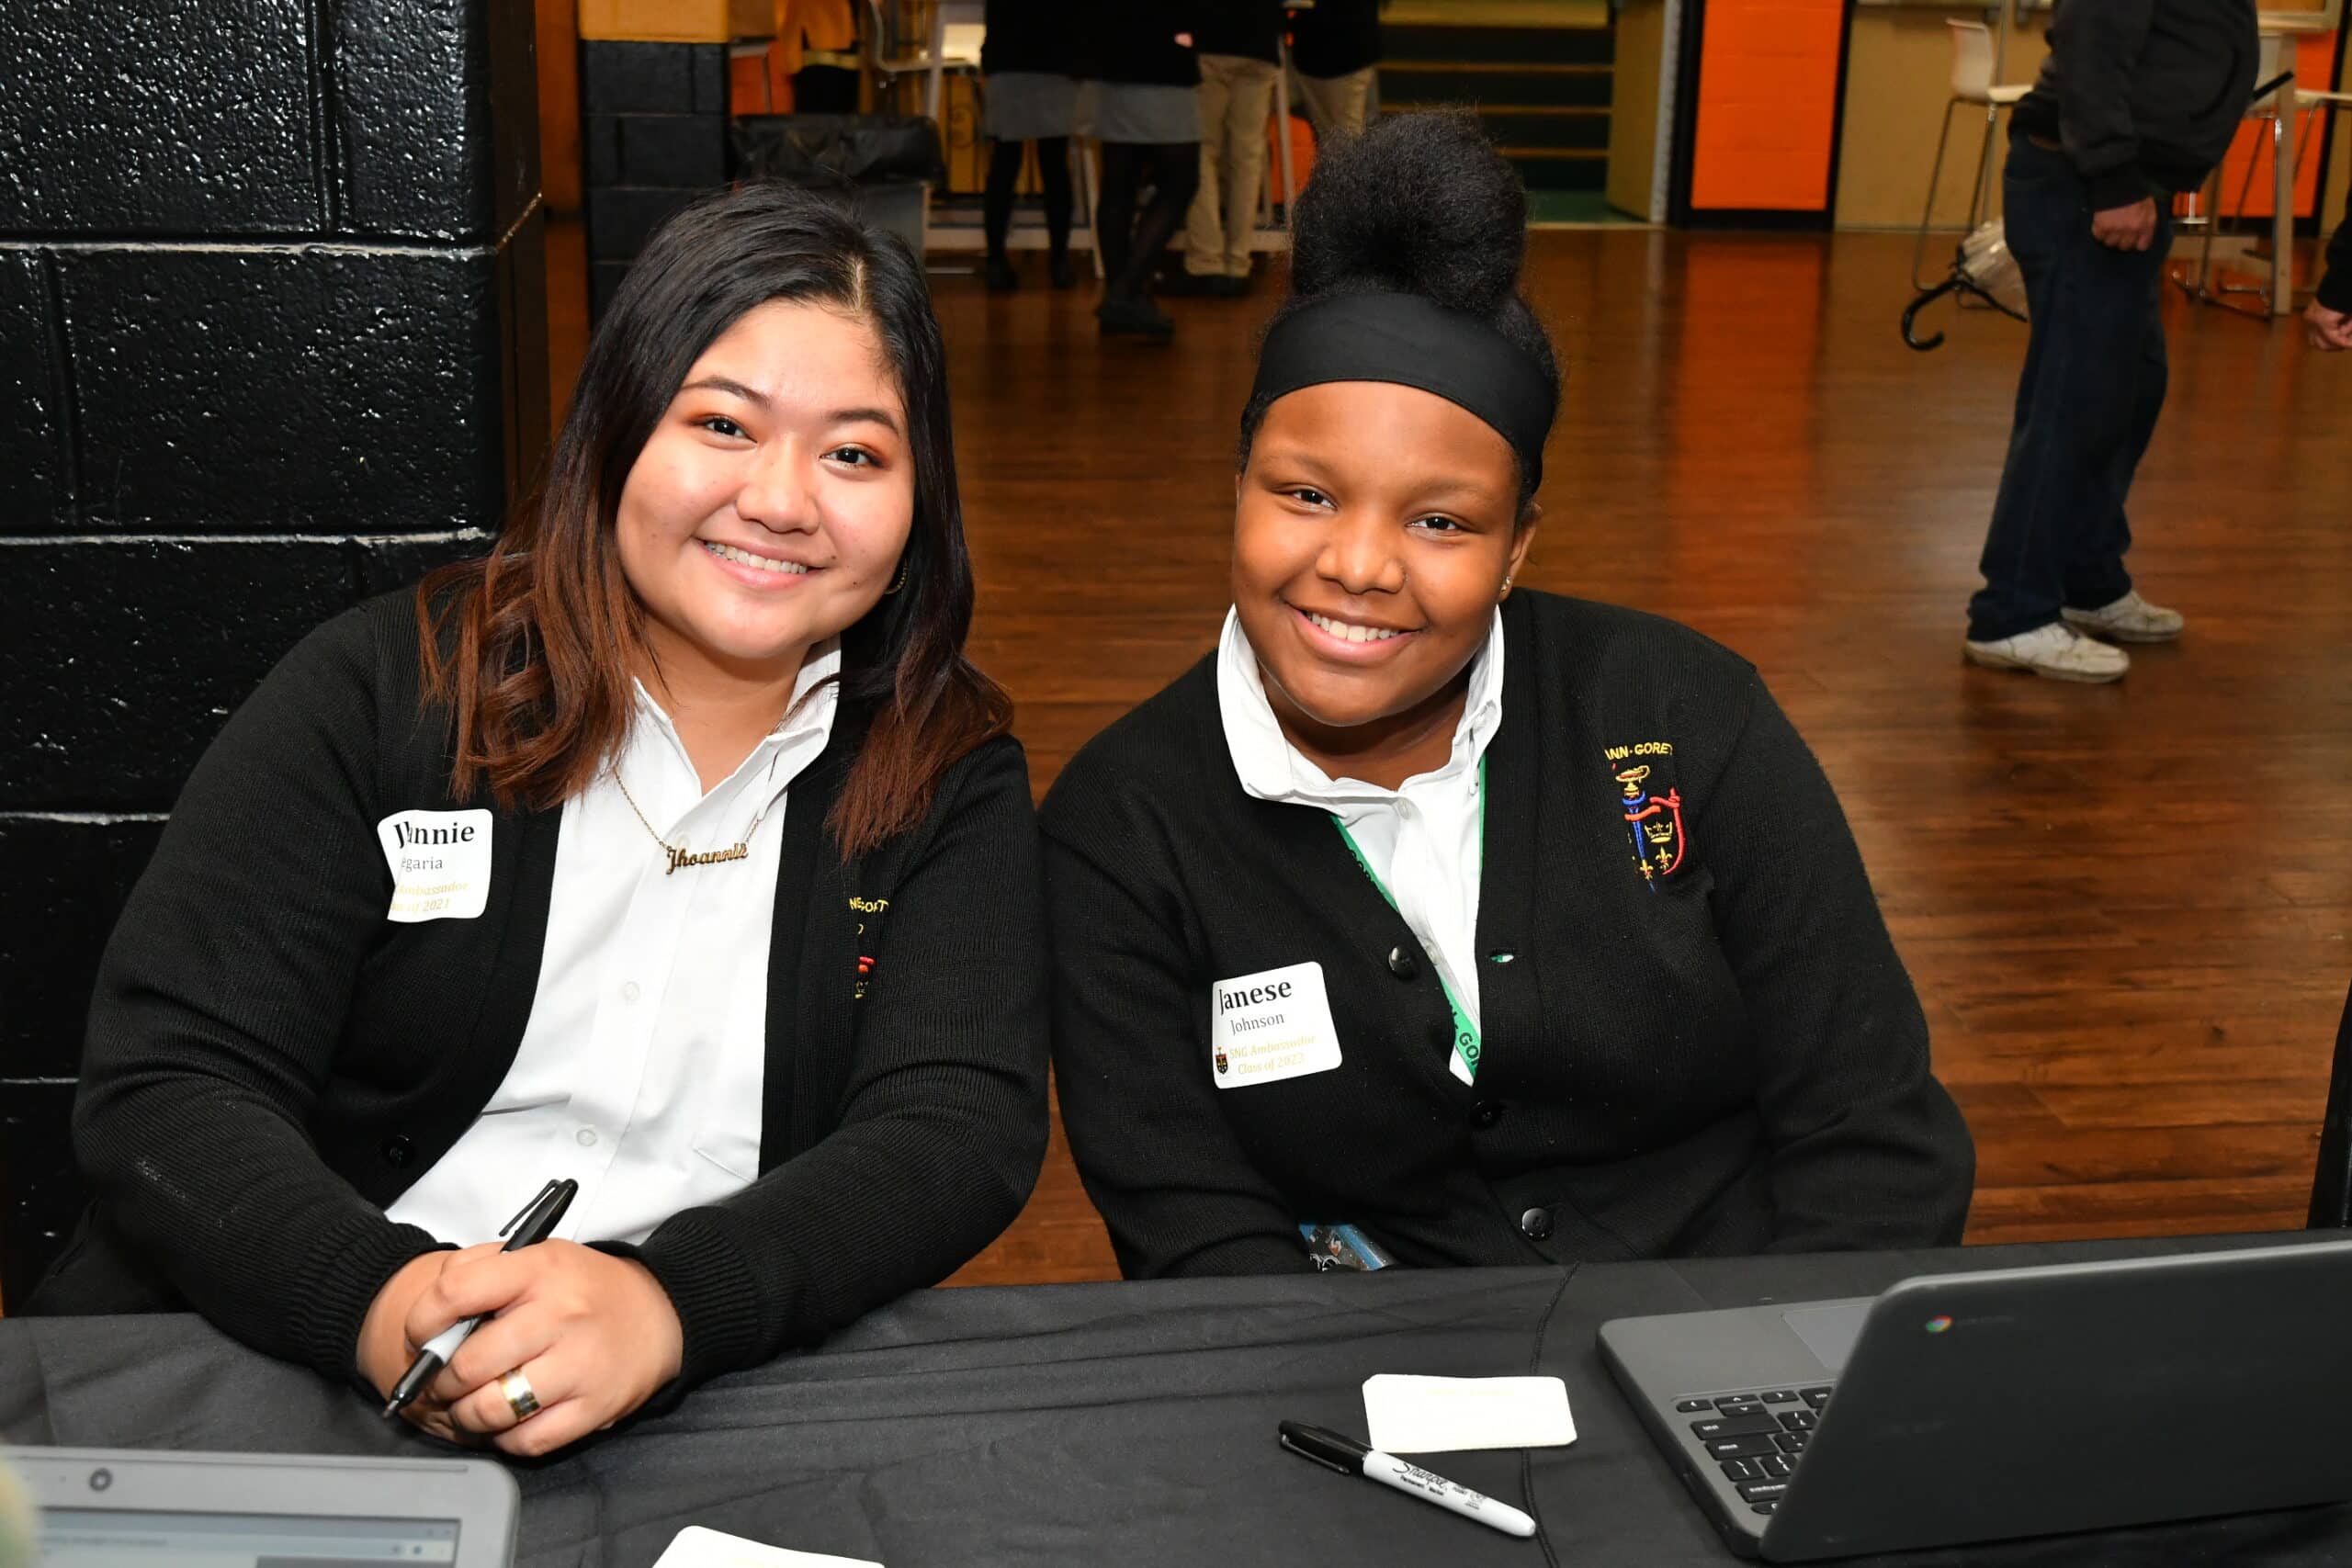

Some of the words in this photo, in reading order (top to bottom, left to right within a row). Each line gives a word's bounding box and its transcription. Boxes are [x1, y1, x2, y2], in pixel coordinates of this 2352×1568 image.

[1219, 981, 1293, 1016] Janese
[1230, 1013, 1285, 1036] Johnson
[1238, 1063, 1262, 1075] Class
[1263, 1059, 1274, 1072] of
